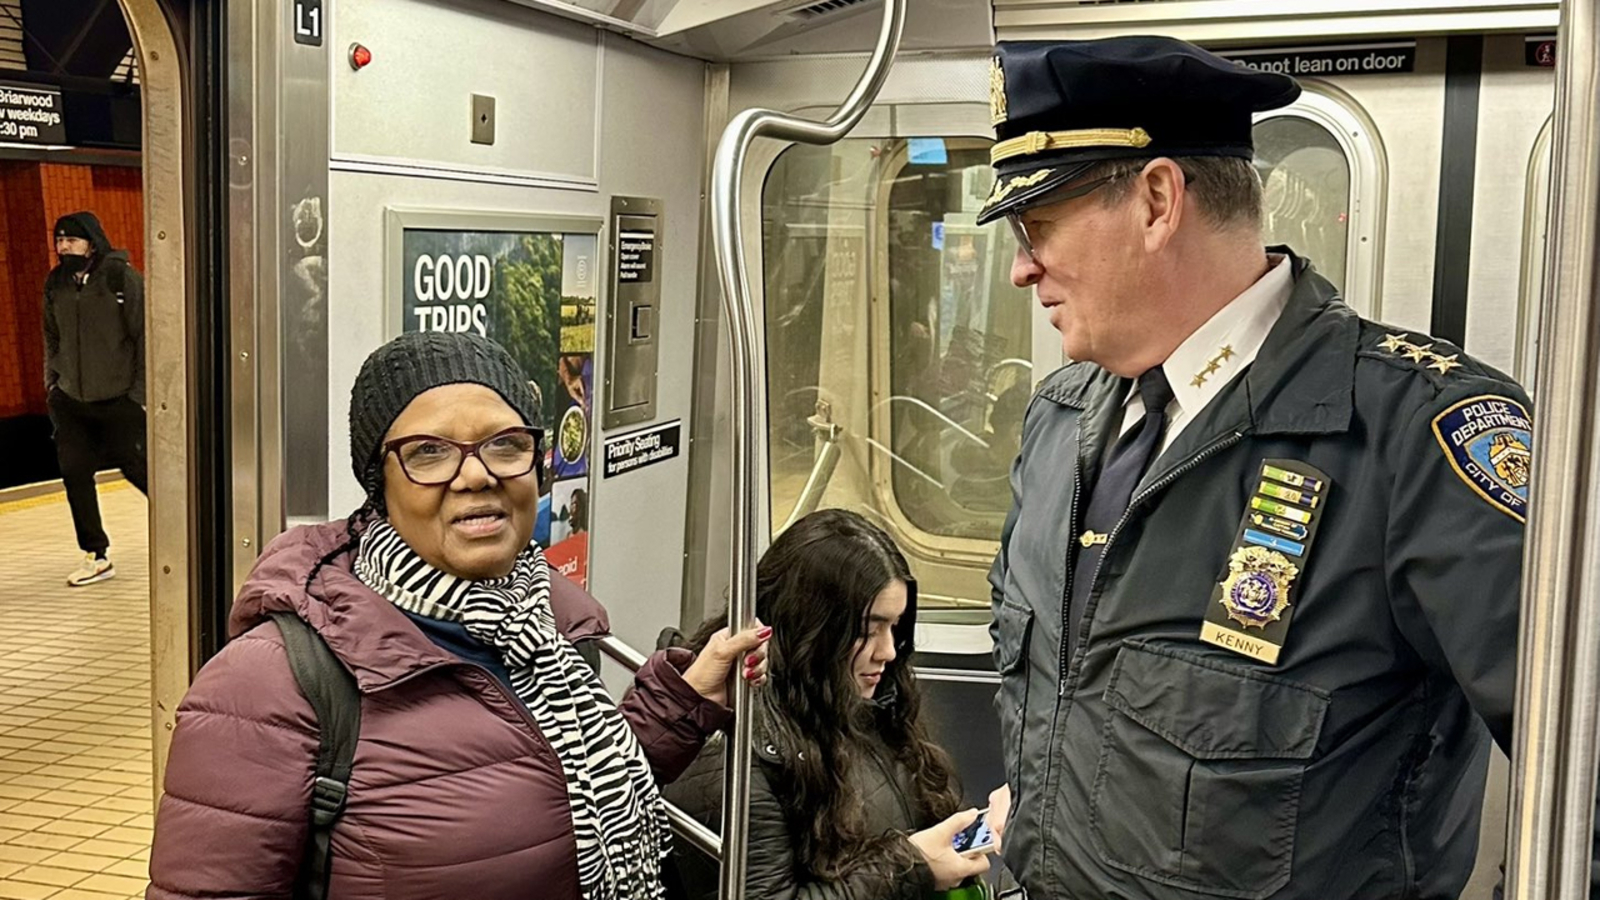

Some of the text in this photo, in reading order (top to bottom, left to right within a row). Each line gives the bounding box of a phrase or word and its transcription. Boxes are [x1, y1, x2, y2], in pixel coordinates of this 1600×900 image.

[297, 4, 319, 37] L1
[1261, 58, 1290, 74] not
[1294, 56, 1332, 73] lean
[1336, 57, 1359, 71] on
[1362, 53, 1406, 70] door
[0, 90, 53, 108] Briarwood
[7, 107, 61, 126] weekdays
[19, 125, 38, 139] pm
[414, 254, 491, 302] GOOD
[414, 303, 486, 339] TRIPS
[1462, 401, 1511, 422] POLICE
[1451, 413, 1532, 447] DEPARTMENT
[608, 433, 660, 459] Priority Seating
[1465, 462, 1522, 506] CITY OF
[1215, 631, 1264, 655] KENNY
